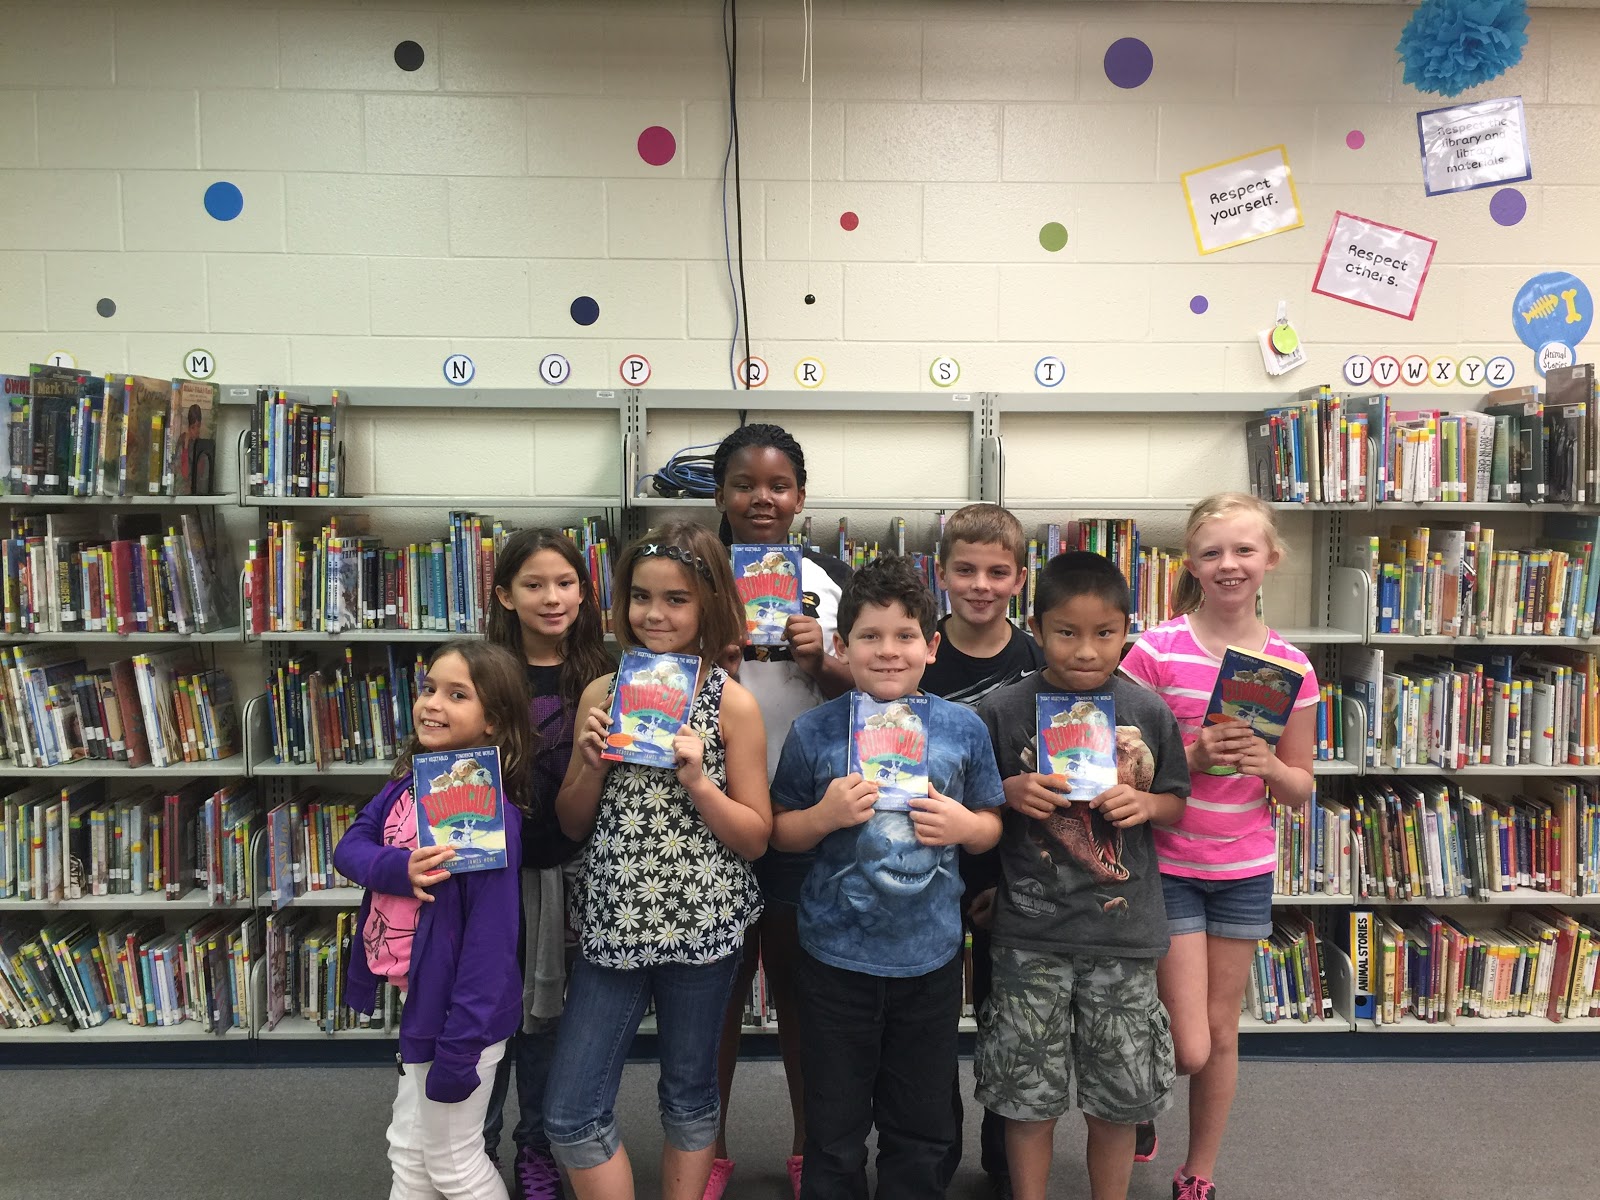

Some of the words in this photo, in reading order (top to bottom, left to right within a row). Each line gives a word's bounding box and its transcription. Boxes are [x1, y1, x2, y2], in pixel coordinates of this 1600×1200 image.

[1437, 121, 1487, 137] Respect
[1489, 118, 1507, 128] the
[1442, 134, 1482, 149] library
[1484, 130, 1506, 141] and
[1456, 146, 1496, 159] library
[1209, 178, 1271, 204] Respect
[1210, 193, 1278, 225] yourself.
[1348, 244, 1408, 271] Respect
[1345, 263, 1398, 287] others.
[1544, 347, 1567, 360] Animal
[192, 356, 209, 373] M
[452, 361, 467, 379] N
[548, 360, 562, 379] O
[630, 361, 644, 380] P
[747, 363, 761, 381] Q
[803, 363, 817, 382] R
[939, 362, 951, 381] S
[1044, 363, 1057, 381] T
[1352, 363, 1364, 379] U
[1380, 363, 1394, 380] V
[1407, 363, 1423, 379] W
[1436, 363, 1451, 379] X
[1466, 363, 1480, 381] Y
[1493, 364, 1505, 380] Z
[1477, 459, 1485, 473] CASE
[736, 572, 798, 605] BUNNICULA
[619, 684, 688, 722] BUNNICULA
[1221, 678, 1291, 716] BUNNICULA
[854, 727, 925, 763] BUNNICULA
[1042, 723, 1111, 757] BUNNICULA
[420, 784, 497, 827] BUNNICULA
[1357, 917, 1368, 957] STORIES
[1358, 958, 1369, 992] ANIMAL
